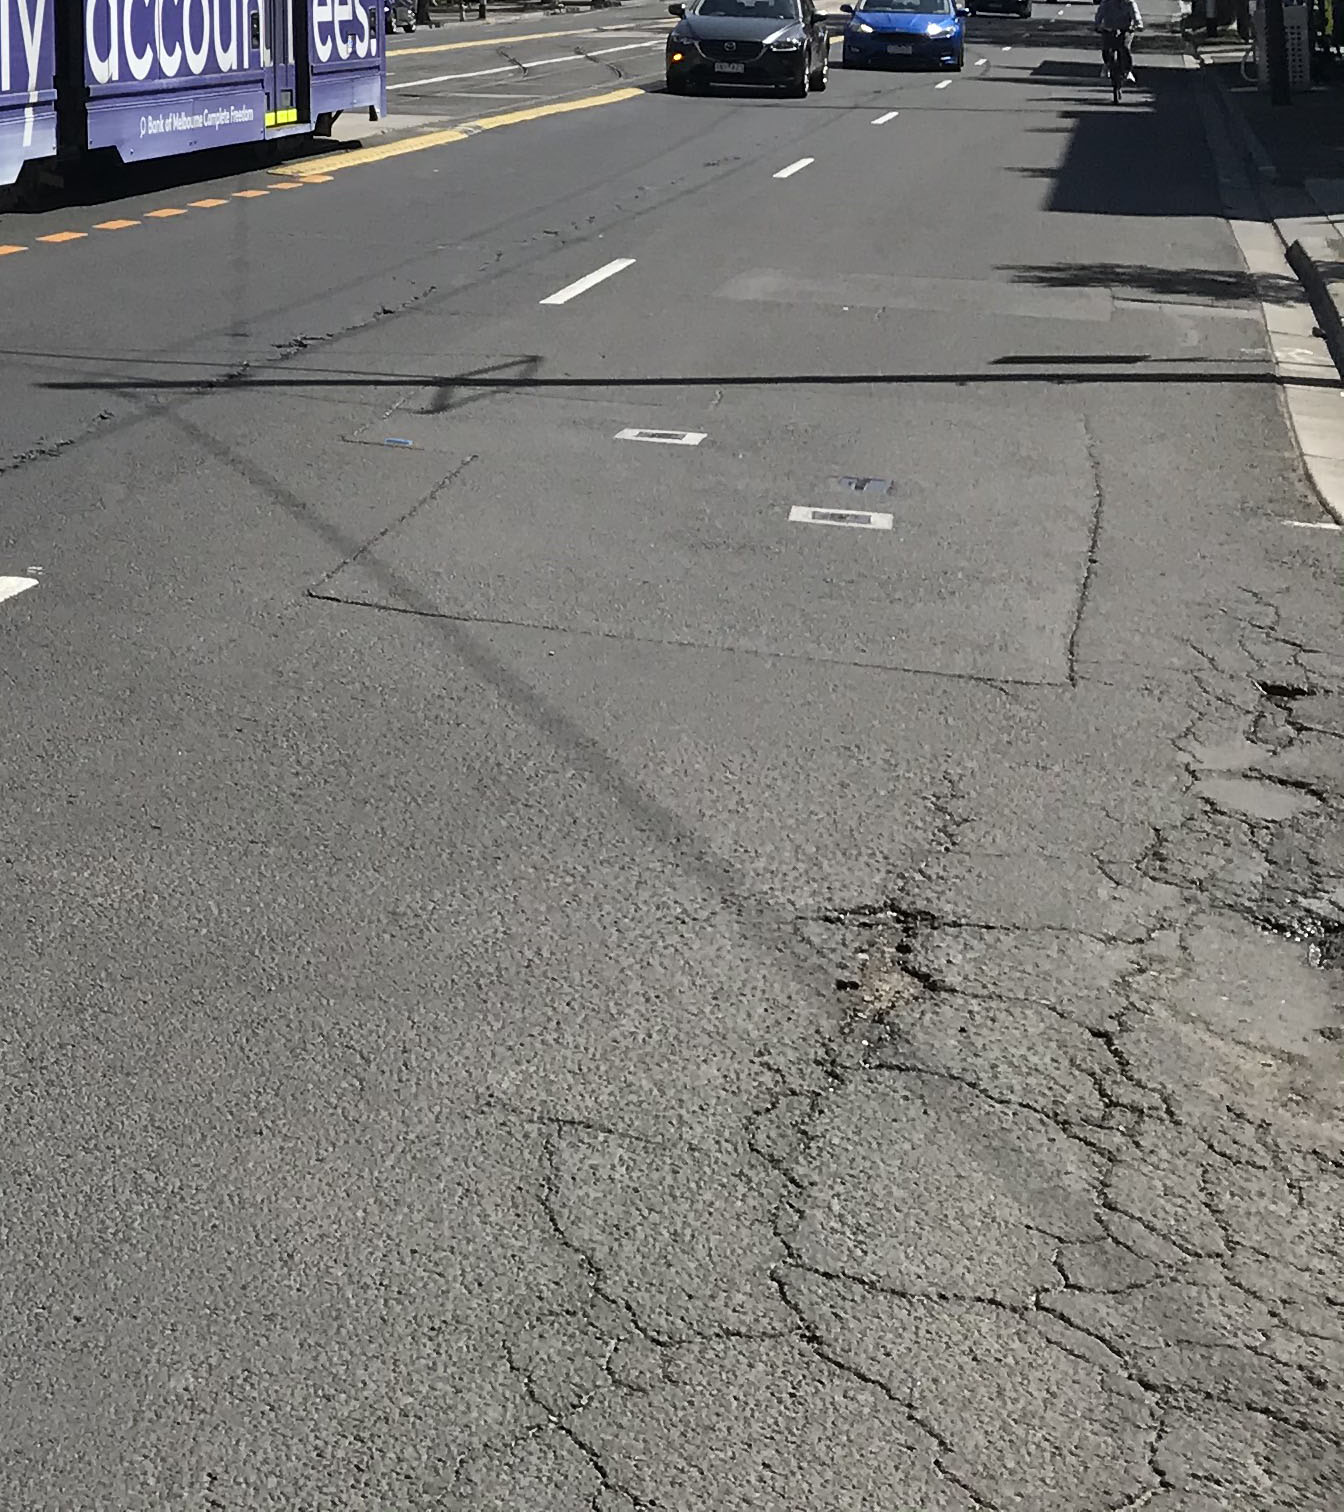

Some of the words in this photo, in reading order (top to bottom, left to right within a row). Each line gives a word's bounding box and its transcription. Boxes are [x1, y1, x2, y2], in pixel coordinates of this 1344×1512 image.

[147, 114, 165, 135] Bank
[164, 112, 173, 132] of
[172, 111, 204, 131] Melbourne
[203, 107, 230, 131] Complete
[230, 104, 254, 124] Freedom
